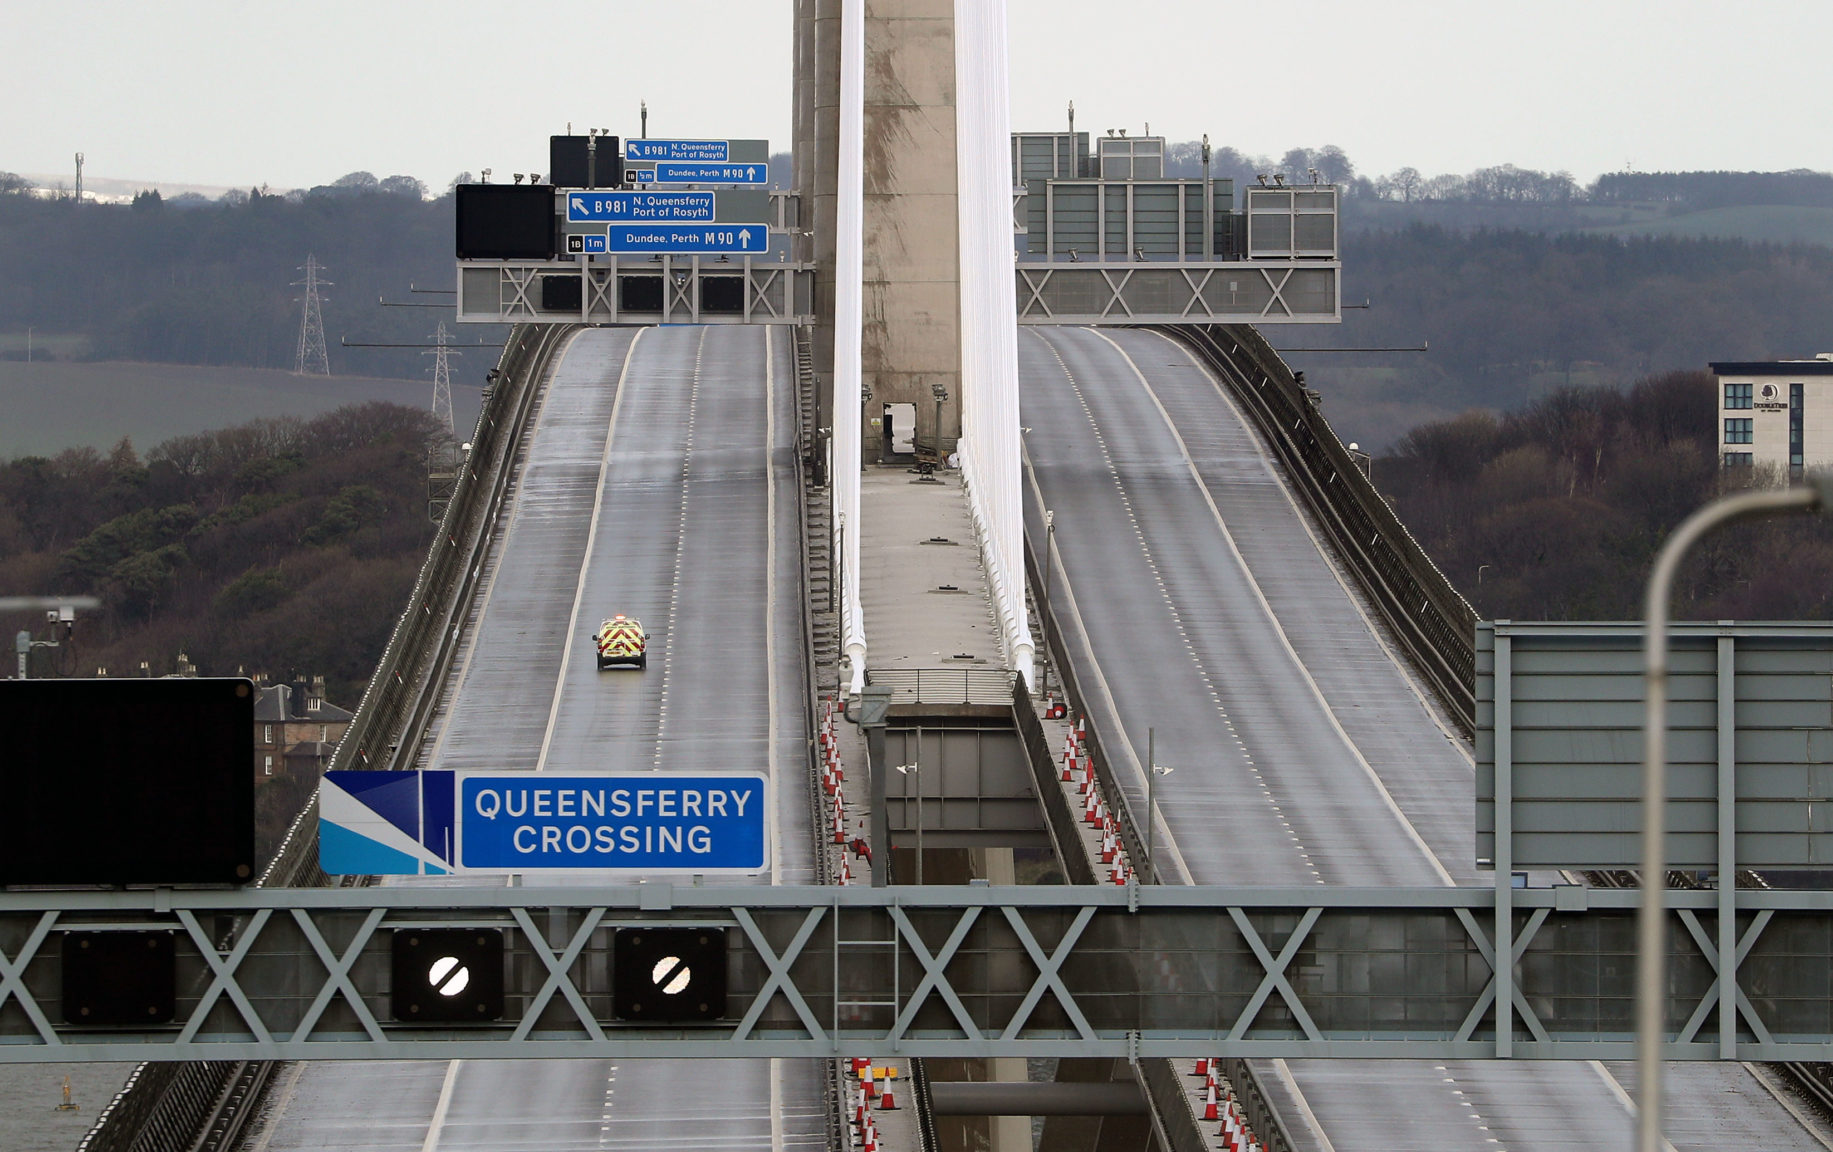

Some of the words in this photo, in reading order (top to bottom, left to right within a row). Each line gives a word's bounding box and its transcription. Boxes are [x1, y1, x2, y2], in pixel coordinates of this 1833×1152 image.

[681, 143, 725, 152] Queensferry
[699, 151, 724, 160] Rosyth
[700, 169, 720, 177] Perth
[633, 196, 645, 206] N.
[647, 196, 710, 207] Queensferry
[633, 207, 655, 217] Port
[658, 207, 670, 217] of
[673, 207, 709, 218] Rosyth
[571, 240, 581, 248] 1B
[626, 233, 668, 244] Dundee,
[672, 233, 699, 243] Perth
[475, 789, 752, 820] QUEENSFERRY
[513, 825, 712, 853] CROSSING
